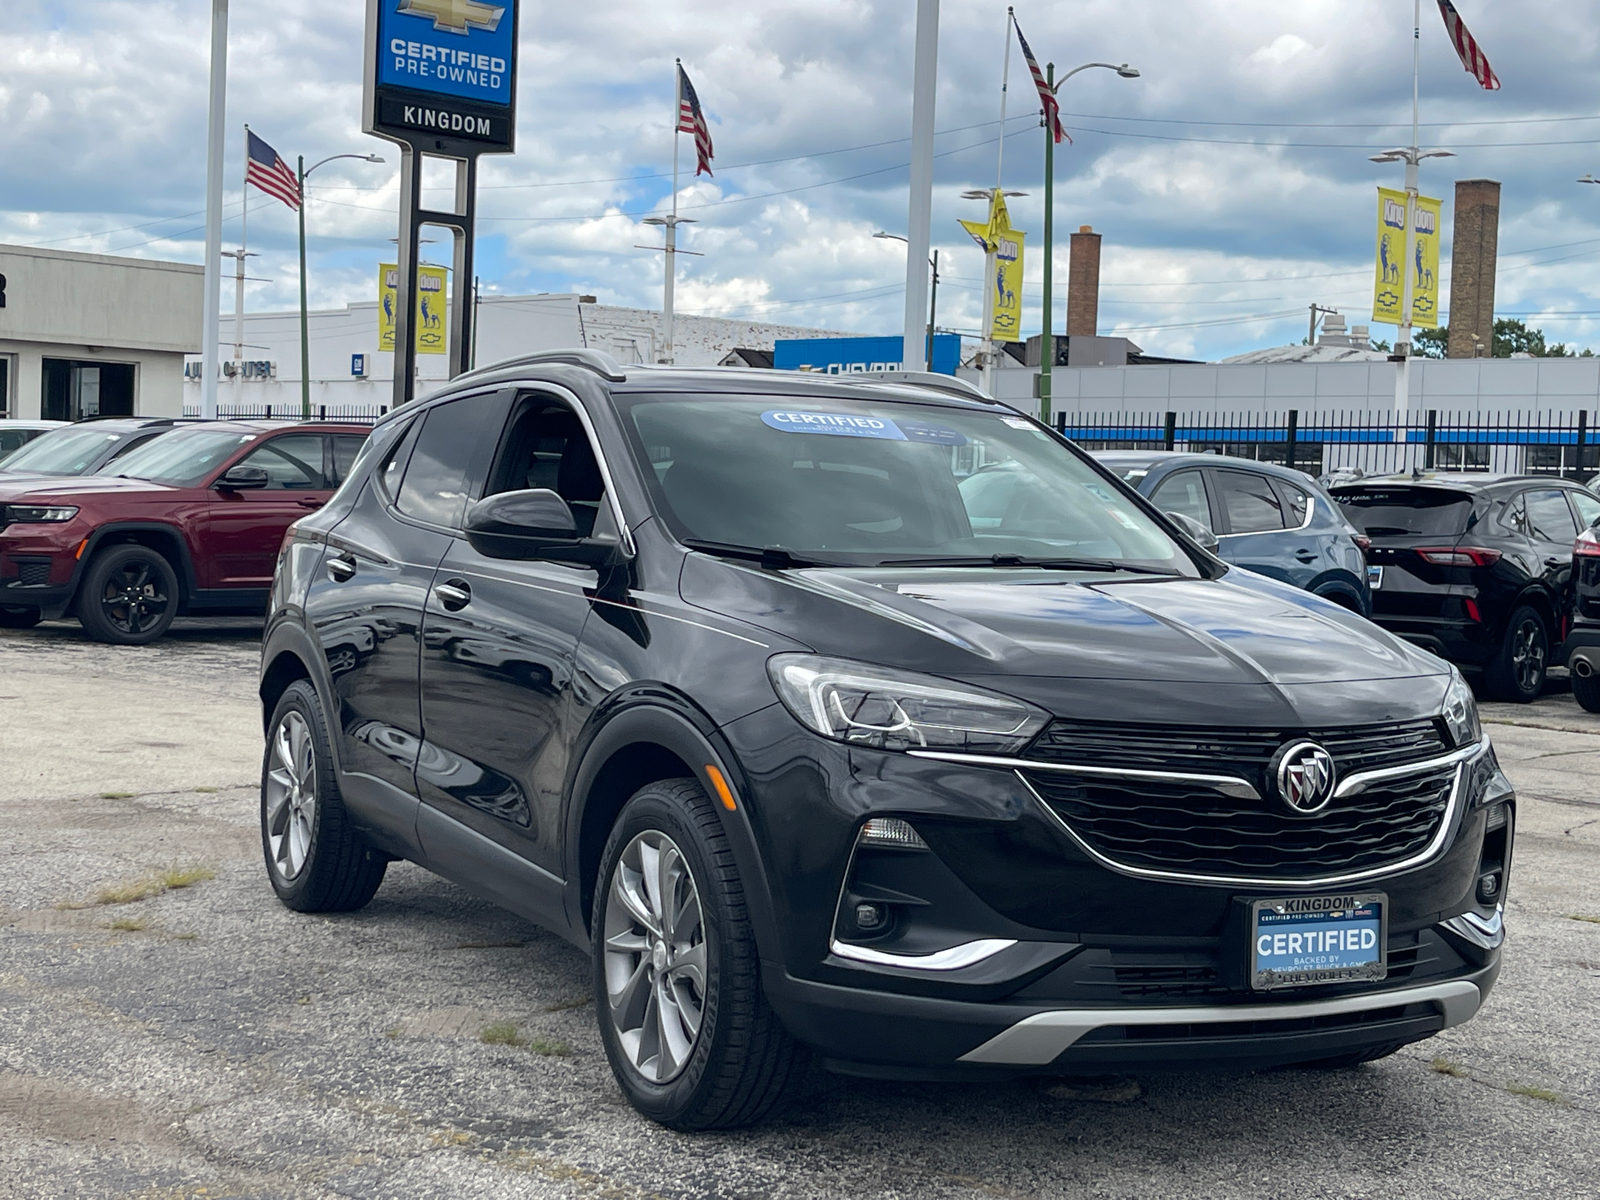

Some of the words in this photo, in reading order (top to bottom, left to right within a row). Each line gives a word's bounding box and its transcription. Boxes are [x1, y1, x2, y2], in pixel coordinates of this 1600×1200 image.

[390, 38, 506, 74] CERTIFIED
[394, 57, 502, 90] PRE-OWNED
[403, 105, 491, 136] KINGDOM
[1383, 198, 1405, 228] King
[1414, 206, 1435, 231] dom
[420, 274, 442, 290] dom
[773, 412, 885, 429] CERTIFIED
[1284, 896, 1354, 912] KINGDOM
[1256, 928, 1377, 956] CERTIFIED
[1293, 956, 1328, 965] BACKED
[1329, 955, 1340, 963] BY
